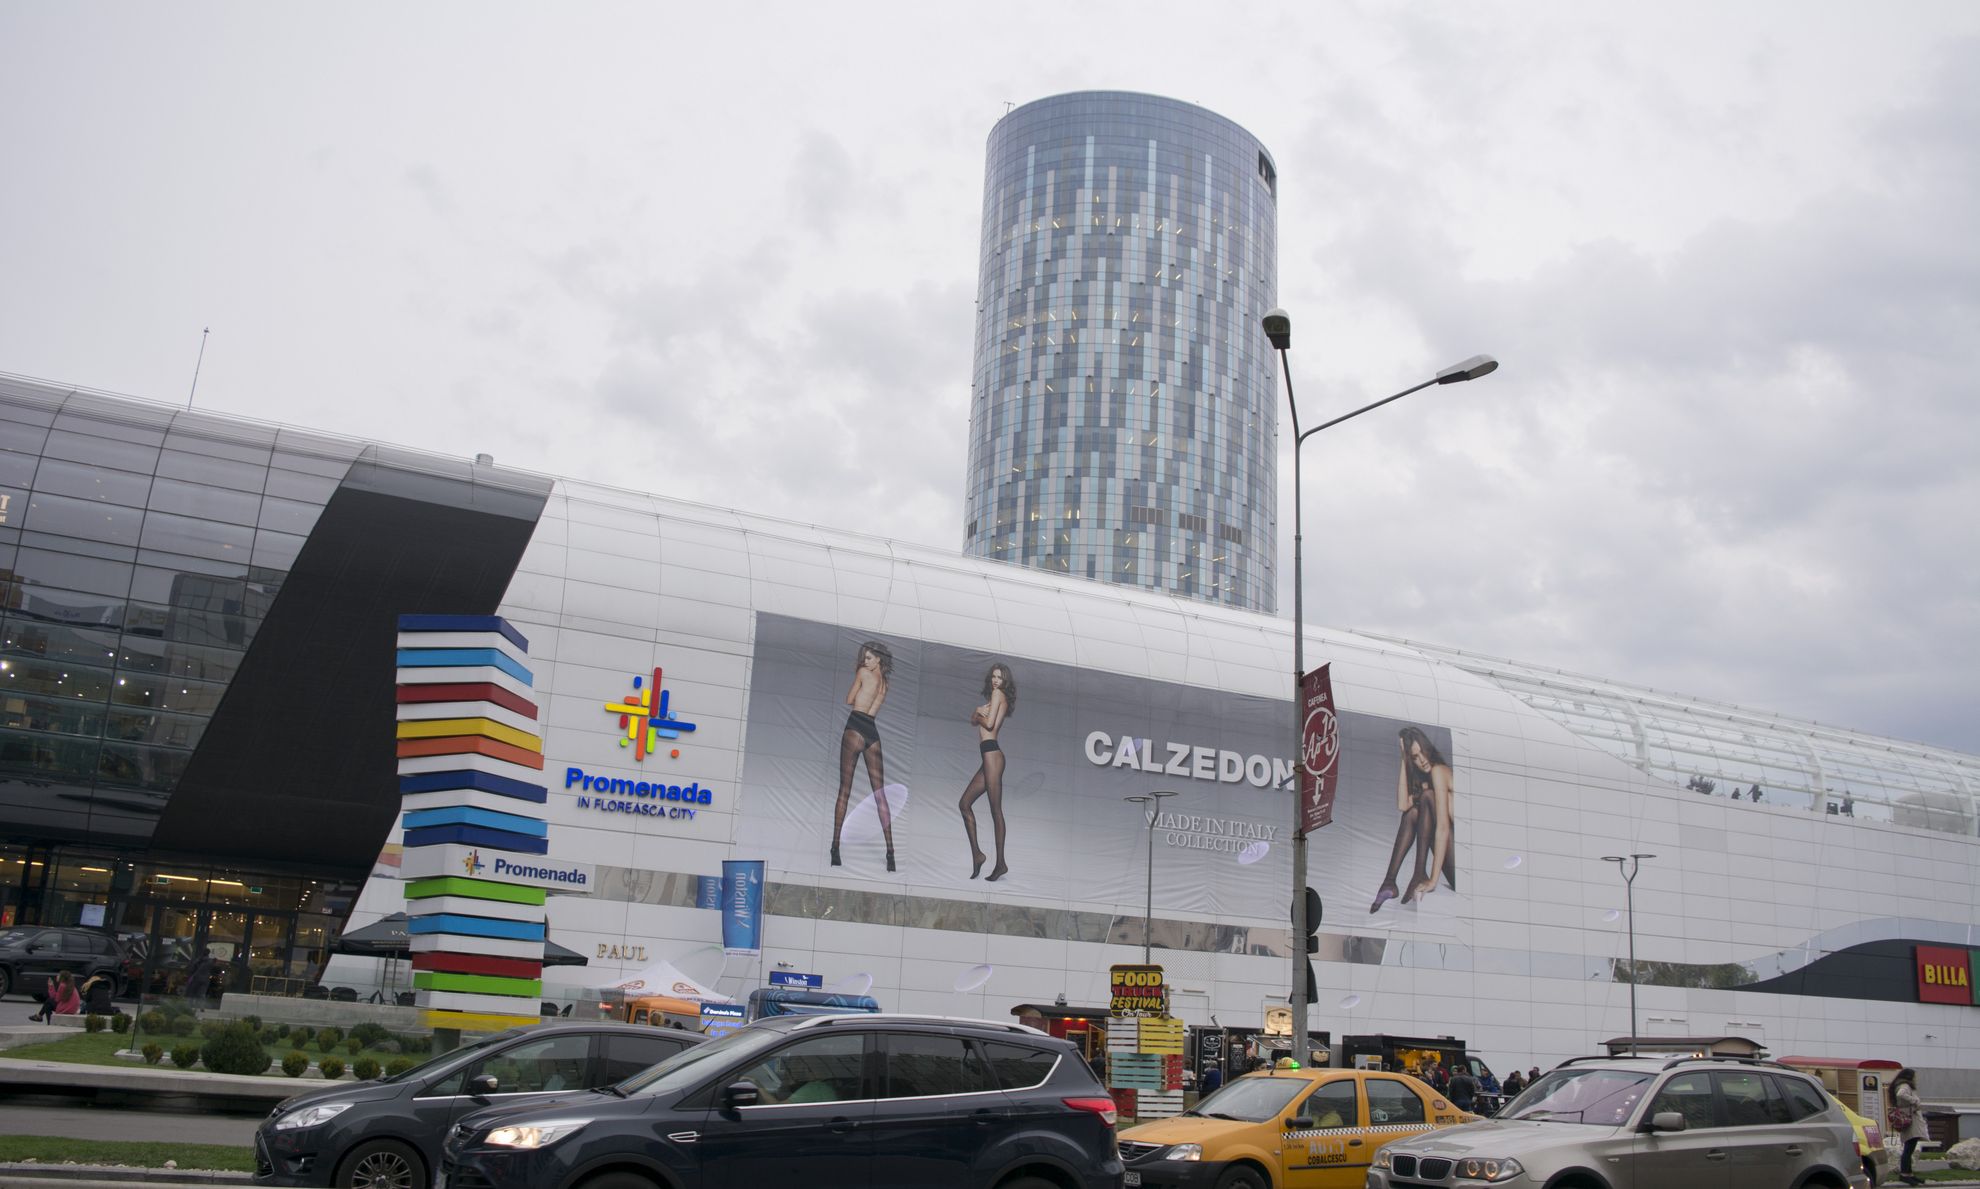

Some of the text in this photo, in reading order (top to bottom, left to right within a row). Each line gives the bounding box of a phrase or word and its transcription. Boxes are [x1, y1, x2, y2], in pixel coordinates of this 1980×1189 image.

[1085, 731, 1294, 791] CALZEDON
[565, 767, 713, 805] Promenada
[577, 796, 697, 821] IN FLOREASCA CITY
[1145, 810, 1278, 841] MADE IN ITALY
[1166, 832, 1260, 856] COLLECTION
[494, 858, 587, 884] Promenada
[596, 943, 649, 962] PAUL
[784, 975, 808, 987] Winston
[1112, 971, 1162, 987] FOOD
[1924, 964, 1968, 986] BILLA
[1110, 996, 1162, 1009] FESTIVAL
[1112, 986, 1162, 997] TRUCK
